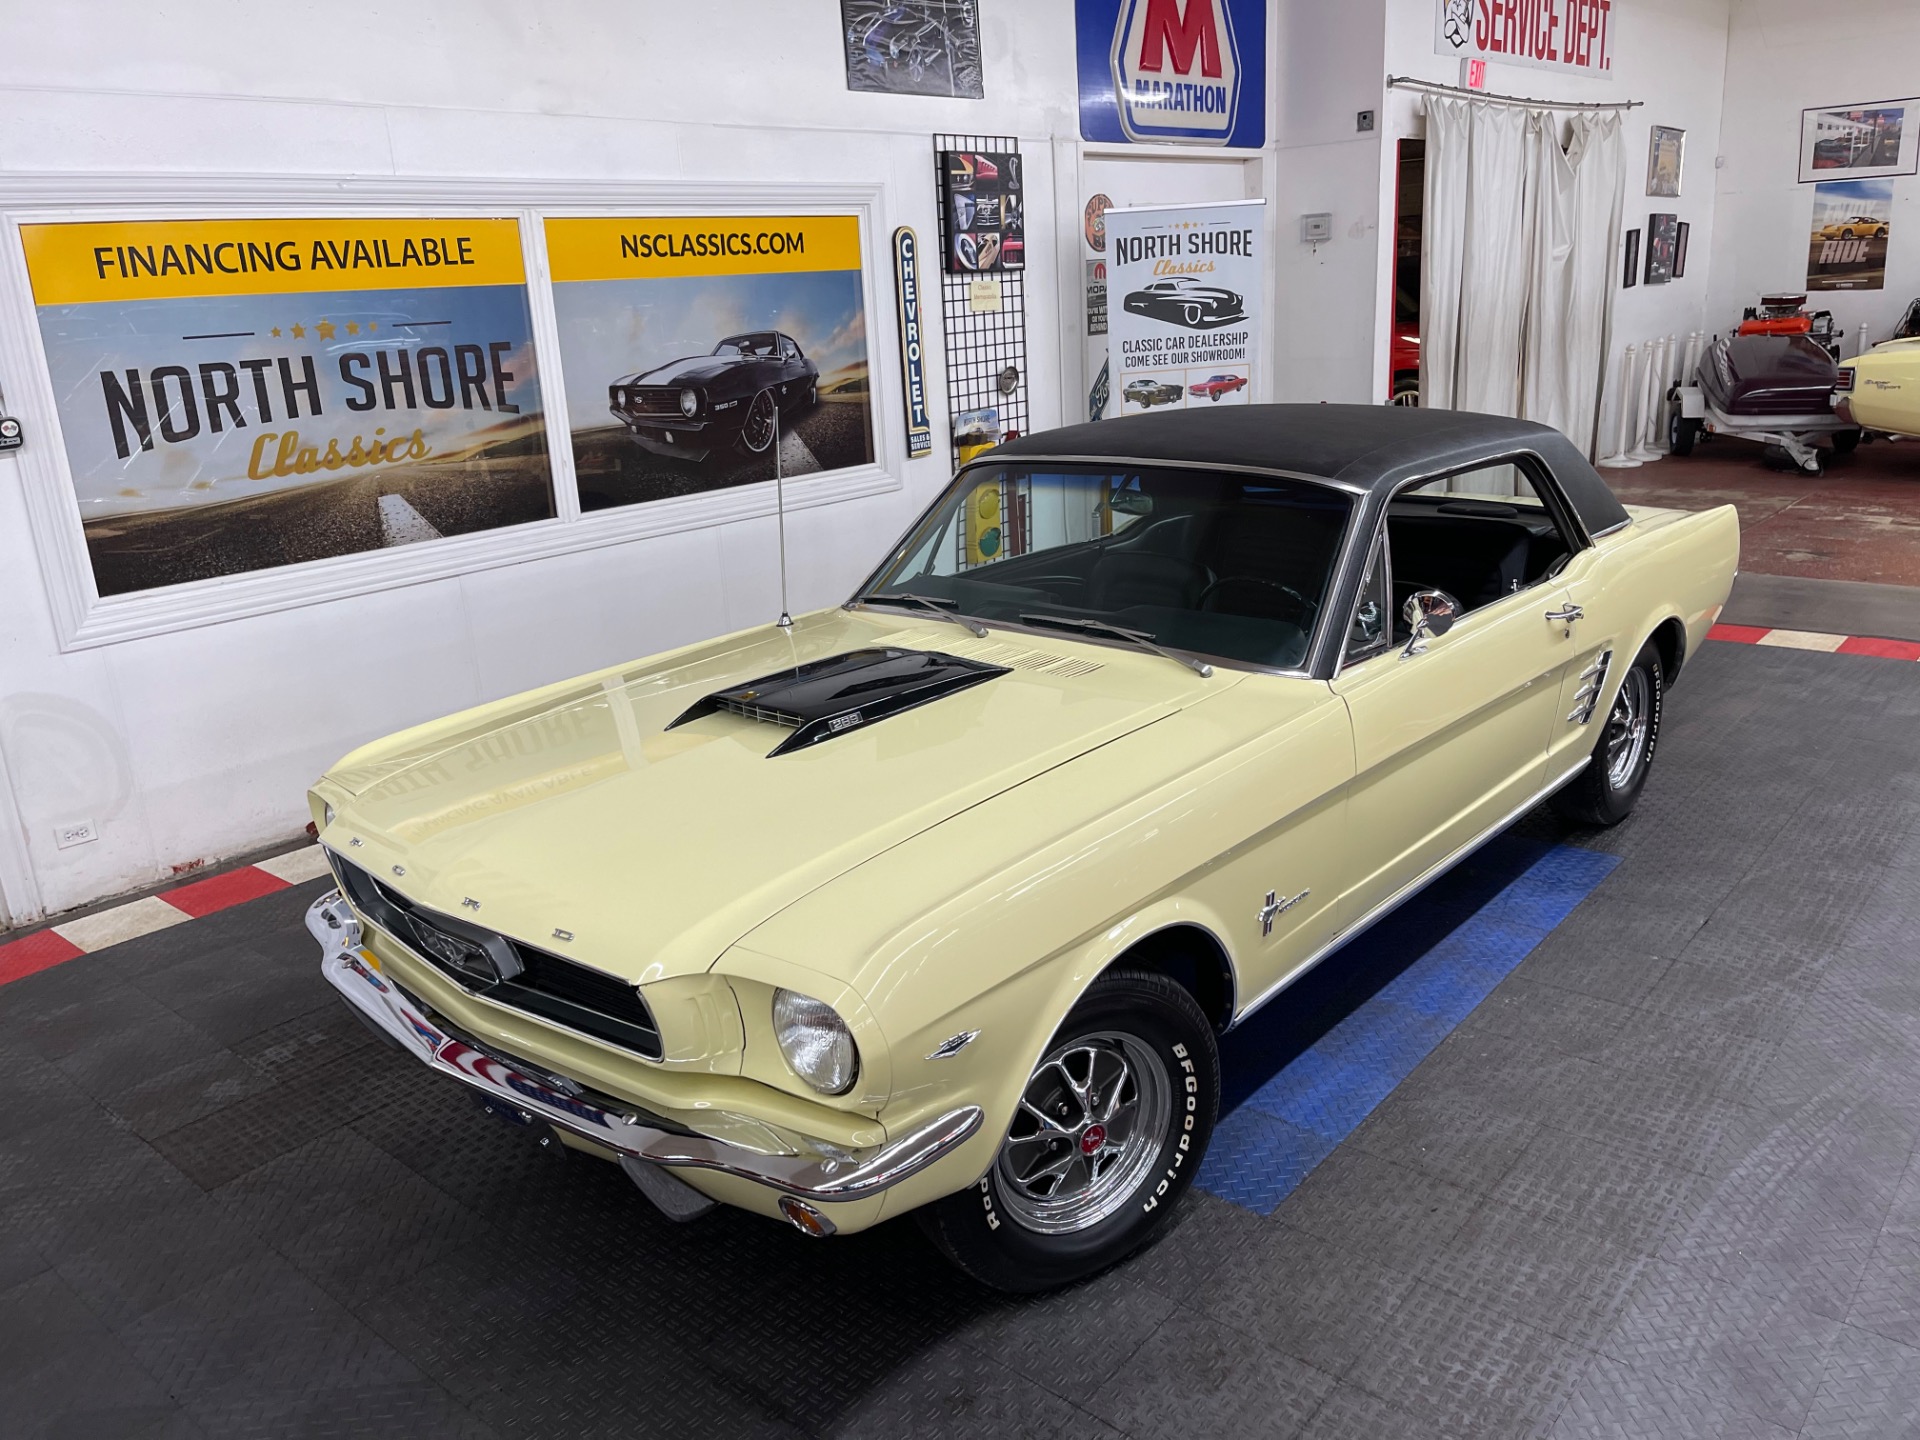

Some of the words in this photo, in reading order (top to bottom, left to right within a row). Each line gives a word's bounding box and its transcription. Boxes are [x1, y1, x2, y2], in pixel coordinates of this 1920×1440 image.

[1476, 0, 1558, 61] SERVICE
[1563, 0, 1611, 70] DEPT.
[1469, 60, 1486, 89] EXIT
[1135, 79, 1226, 114] MARATHON
[93, 240, 301, 279] FINANCING
[310, 236, 475, 271] AVAILABLE
[620, 232, 805, 258] NSCLASSICS.COM
[1116, 233, 1181, 267] NORTH
[1188, 229, 1252, 257] SHORE
[1819, 240, 1869, 264] RIDE
[1153, 259, 1216, 276] Classics
[902, 239, 923, 423] CHEVROLET
[1122, 338, 1163, 354] CLASSIC
[1165, 336, 1185, 351] CAR
[1188, 331, 1249, 349] DEALERSHIP
[1125, 354, 1150, 368] COME
[1152, 353, 1168, 366] SEE
[1171, 351, 1189, 365] OUR
[1191, 347, 1246, 363] SHOWROOM!
[100, 355, 323, 460] NORTH
[339, 341, 520, 415] SHORE
[247, 427, 432, 481] Classics
[1143, 1042, 1198, 1213] BFGoodrich
[980, 1177, 1000, 1231] Rad
